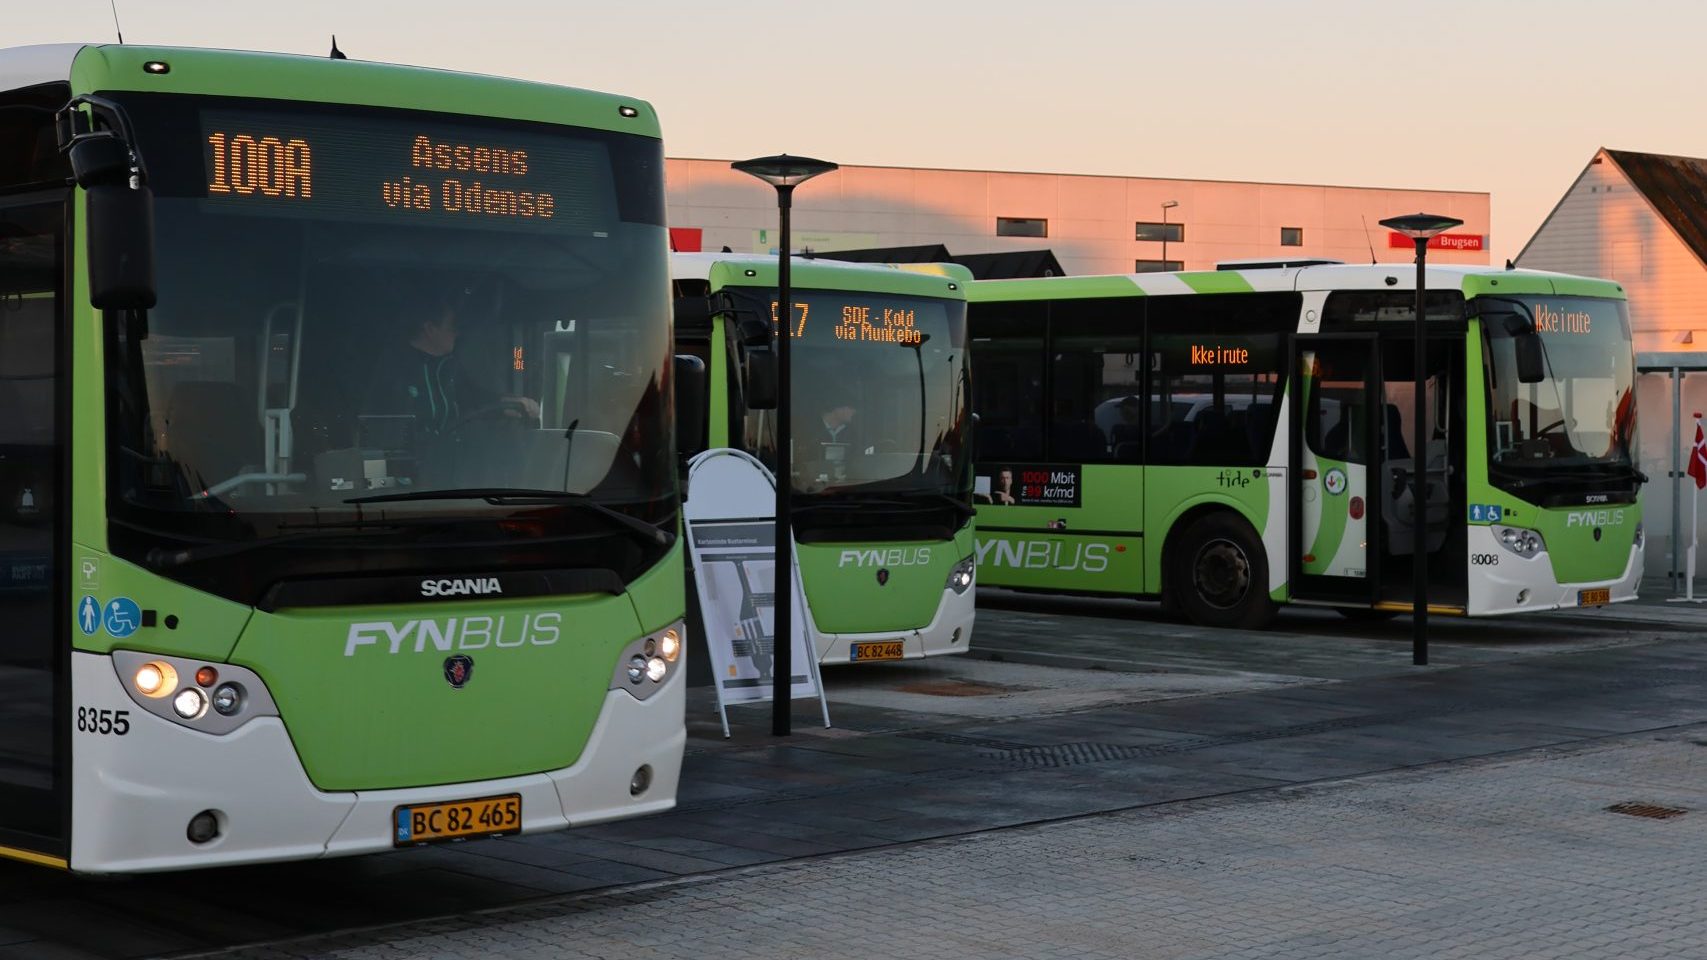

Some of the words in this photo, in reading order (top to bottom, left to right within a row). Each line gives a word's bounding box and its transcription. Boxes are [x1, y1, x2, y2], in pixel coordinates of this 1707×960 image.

[208, 132, 311, 198] 100A
[412, 135, 528, 175] Assens
[383, 176, 431, 209] via
[442, 180, 554, 218] Odense
[842, 306, 870, 325] SDE
[884, 308, 914, 327] Kold
[1535, 304, 1559, 332] Ikke
[1567, 310, 1591, 334] rute
[835, 323, 856, 340] via
[861, 322, 921, 343] Munkebo
[1191, 345, 1215, 365] Ikke
[1223, 347, 1248, 364] rute
[1023, 471, 1048, 483] 1000
[1051, 471, 1076, 485] Mbit
[1216, 470, 1250, 488] tide
[1043, 485, 1075, 498] kr/md
[1567, 509, 1624, 527] FYNBUS
[838, 548, 932, 568] FYNBUS
[976, 538, 1110, 572] YNBUS
[1471, 553, 1499, 566] 8008
[421, 578, 502, 597] SCANIA
[344, 612, 562, 657] FYNBUS
[857, 645, 870, 658] BC
[872, 645, 883, 658] 82
[885, 644, 903, 657] 448
[77, 706, 130, 736] 8355
[413, 809, 442, 835] BC
[447, 807, 473, 832] 82
[479, 802, 518, 827] 465
